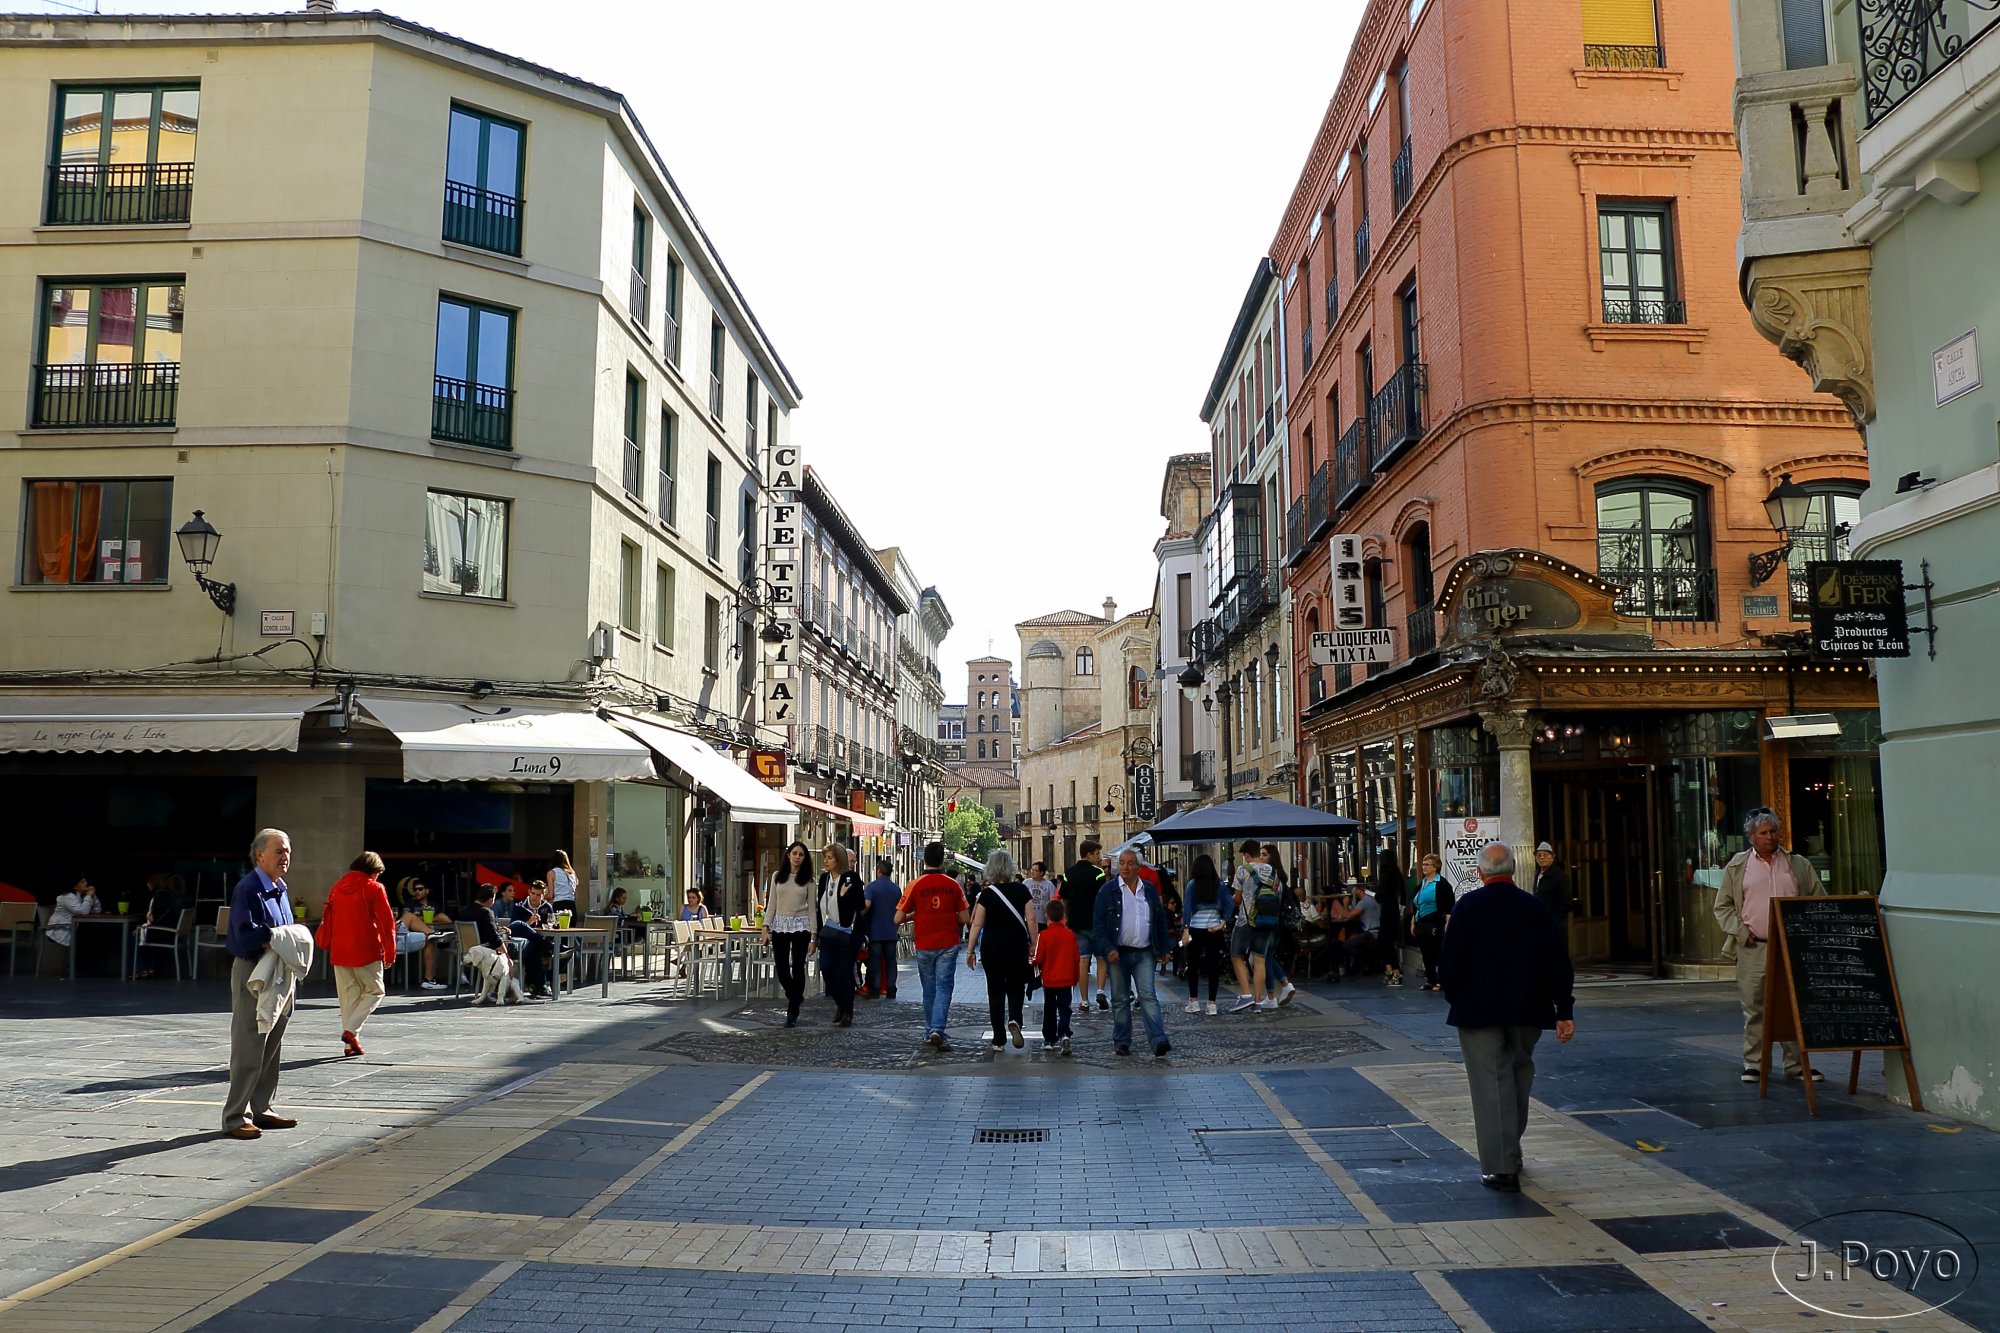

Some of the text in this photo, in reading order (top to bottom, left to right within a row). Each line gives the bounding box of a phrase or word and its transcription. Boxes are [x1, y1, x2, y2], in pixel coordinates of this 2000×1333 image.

[1946, 348, 1963, 365] CALLE
[1337, 539, 1363, 625] IRIS
[1842, 575, 1898, 585] DESPENSA
[1848, 585, 1891, 605] FER
[1745, 606, 1777, 615] CERVANTES
[1312, 630, 1391, 648] PELUQUERIA
[1834, 626, 1888, 638] Productos
[1820, 638, 1904, 652] Típicos de León
[1329, 647, 1376, 662] MIXTA
[32, 725, 167, 749] La mejor Copa de León
[508, 755, 561, 777] Luna 9
[1139, 768, 1151, 812] HOTEL
[1457, 848, 1481, 856] PART
[932, 896, 940, 909] 9
